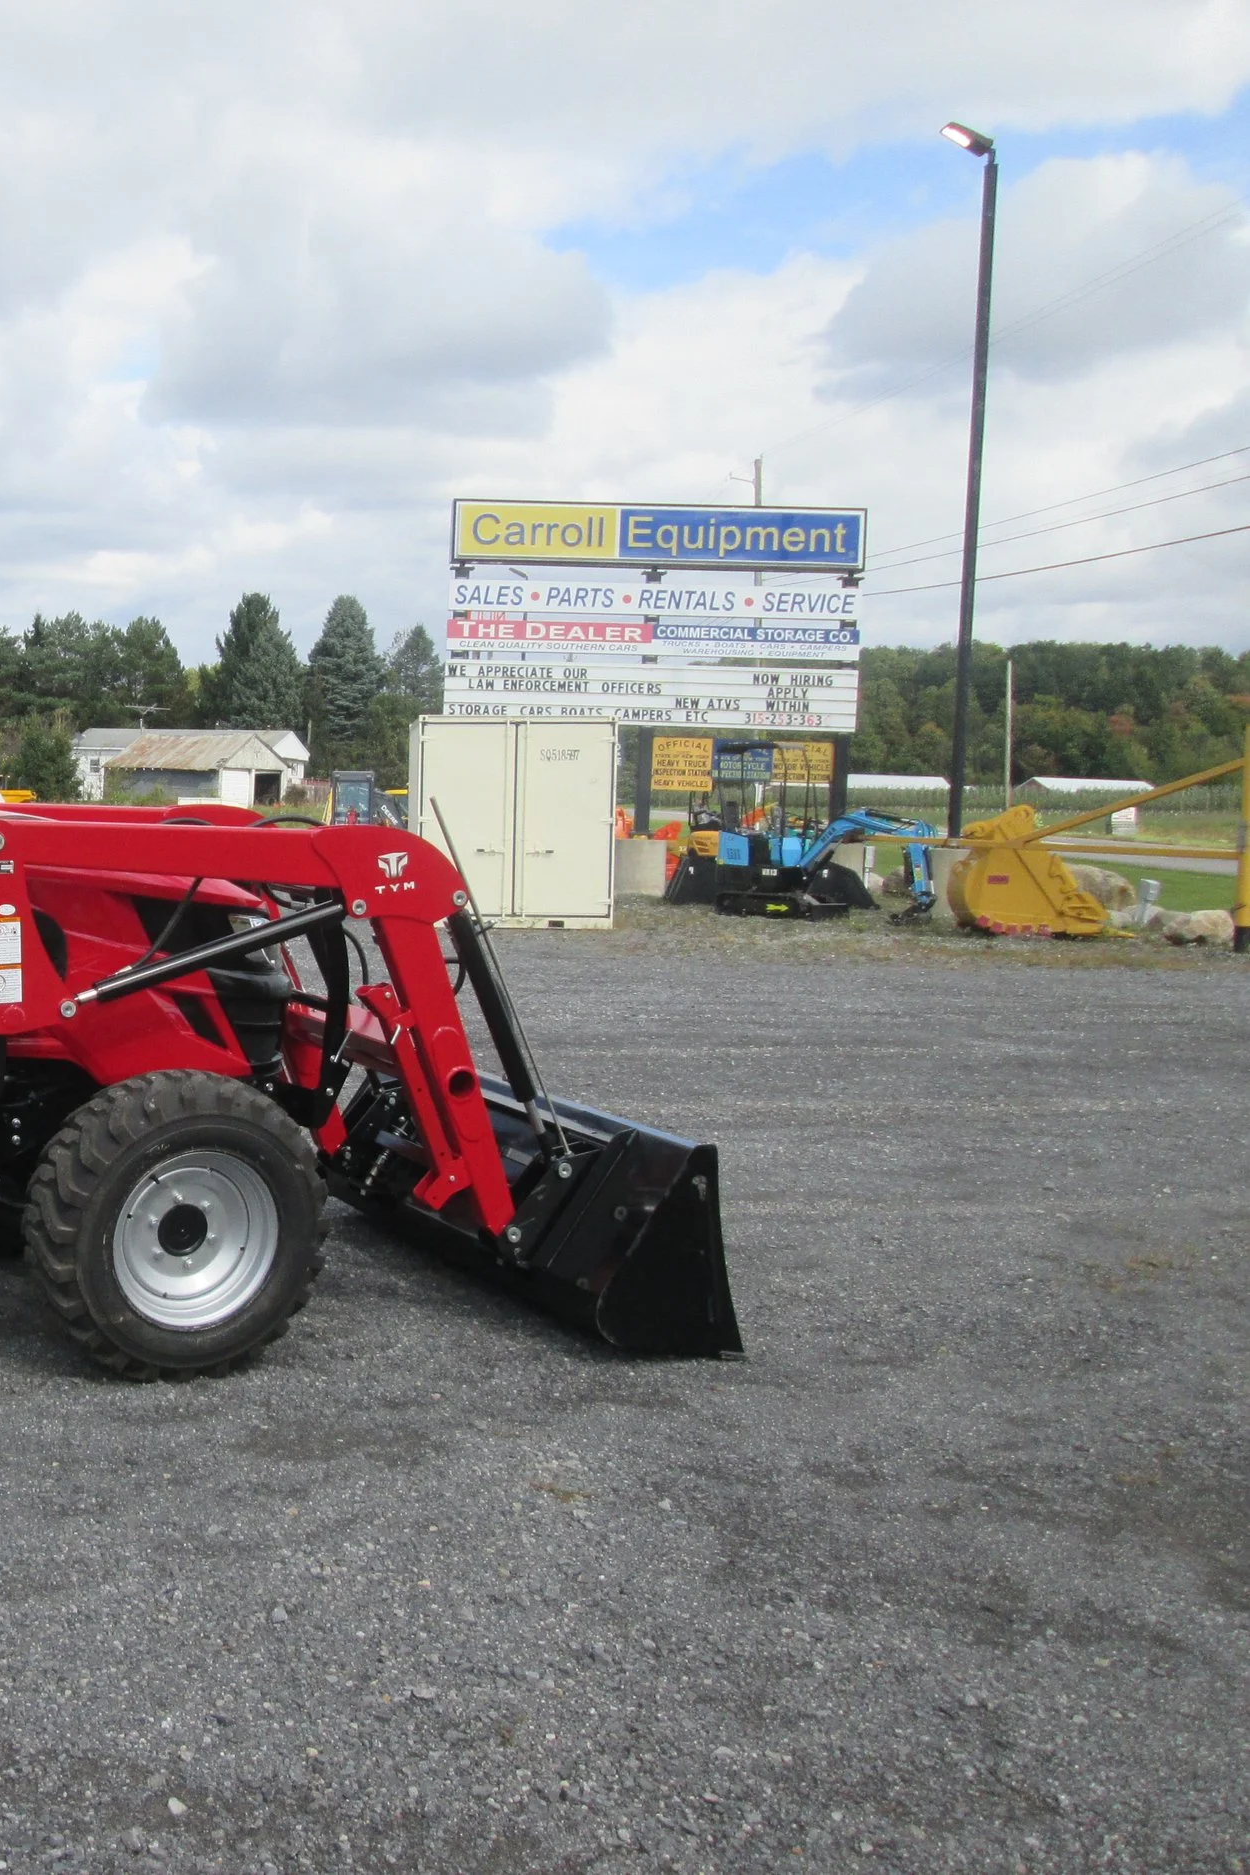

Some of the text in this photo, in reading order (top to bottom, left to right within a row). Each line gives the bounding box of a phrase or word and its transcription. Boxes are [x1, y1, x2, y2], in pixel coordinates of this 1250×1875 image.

[472, 513, 847, 558] Carroll Equipment
[454, 585, 855, 614] SALES PARTS RENTALS SERVICE
[456, 621, 643, 642] THE DEALER
[656, 626, 854, 643] COMMERCIAL STORAGE CO.
[459, 640, 638, 652] CLEAN QUALITY SOUTHERN CARS
[661, 640, 702, 648] TRUCKS
[799, 644, 847, 652] CAMPERS
[682, 648, 755, 656] WAREHOUSING
[448, 665, 588, 679] WE APPRECIATE OUR
[468, 679, 662, 694] LAW ENFORCEMENT OFFICERS
[753, 674, 833, 687] NOW HIRING
[767, 687, 809, 699] APPLY
[675, 697, 740, 711] NEW ATVS
[765, 699, 810, 712] WITHIN
[448, 704, 709, 722] STORAGE CARS BOATS CAMPERS ETC
[745, 713, 831, 727] 315-253-363
[657, 740, 709, 753] OFFICIAL
[656, 759, 707, 768] HEAVY TRUCK
[653, 768, 711, 777] INSPECTION STATION
[654, 778, 709, 788] HEAVY VEHICLES
[380, 804, 399, 826] DEERE
[374, 881, 415, 894] TYM
